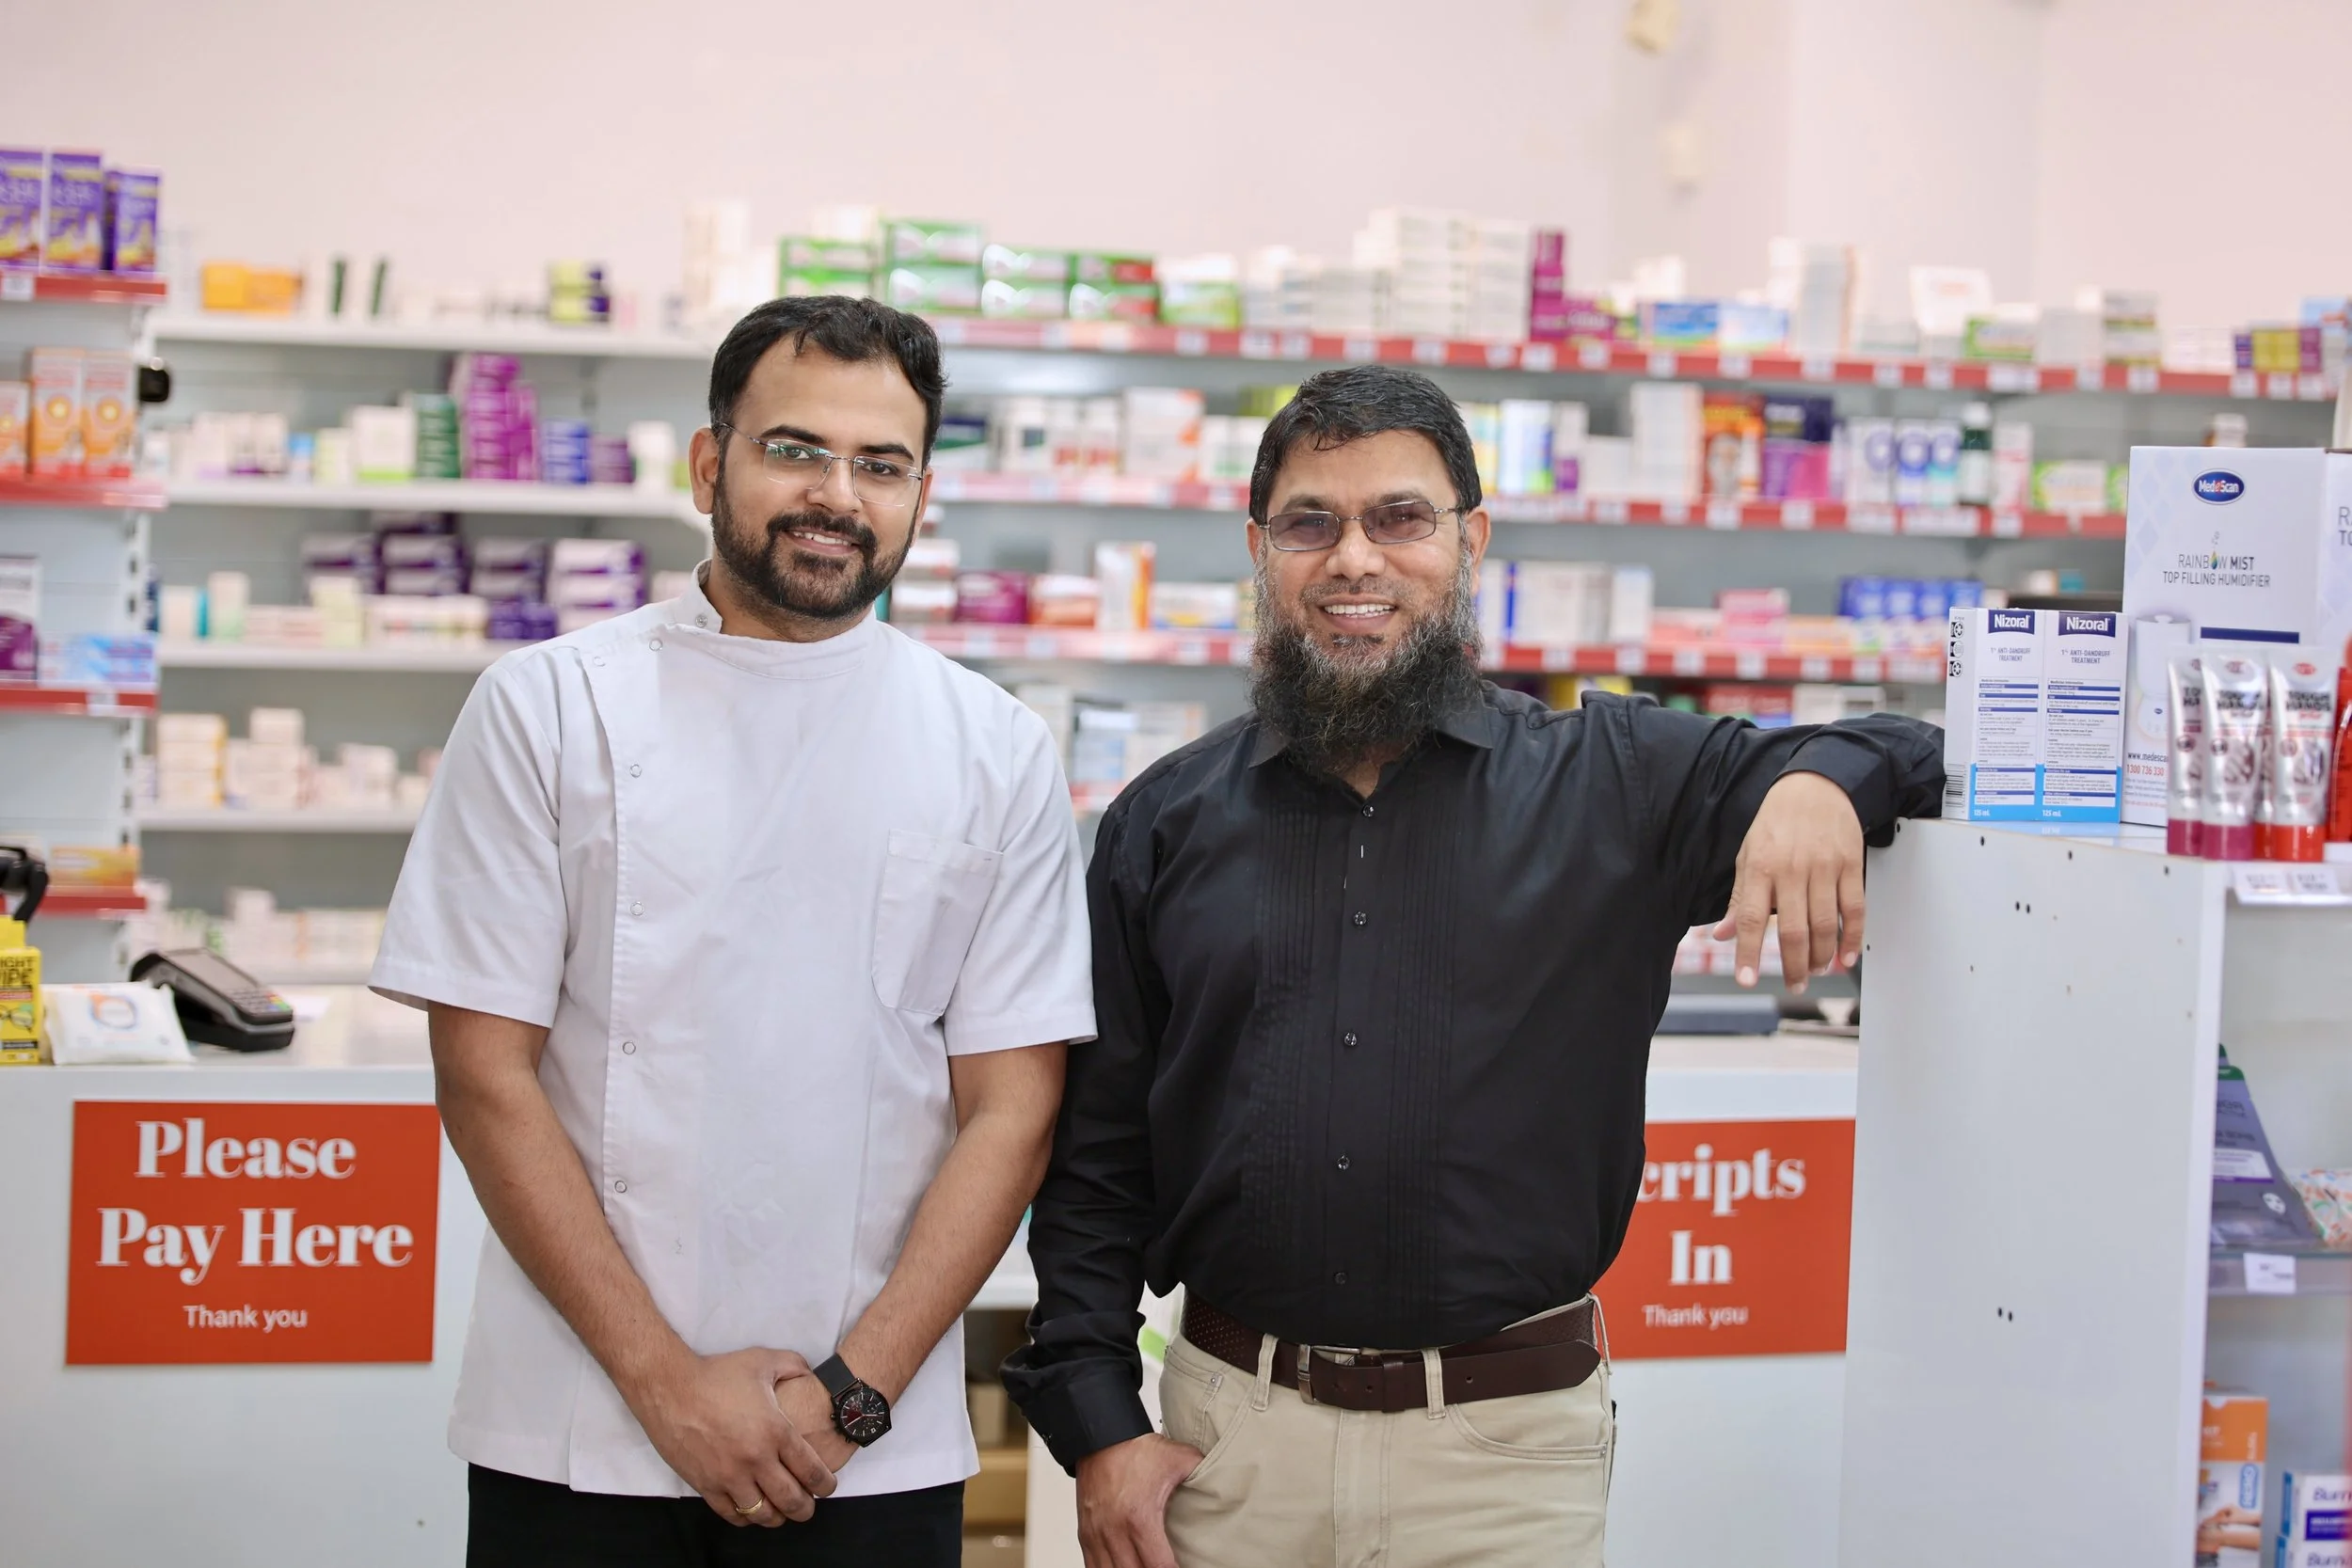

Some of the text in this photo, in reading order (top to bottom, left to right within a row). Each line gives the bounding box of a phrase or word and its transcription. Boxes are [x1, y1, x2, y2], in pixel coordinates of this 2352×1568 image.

[2198, 480, 2239, 493] MedeScan
[2230, 556, 2254, 571] MIST
[2163, 570, 2271, 588] TOP FILLING HUMIDIFIER
[1994, 614, 2029, 628] Nizoral
[2066, 617, 2109, 632] Nizoral
[2070, 649, 2110, 657] ANTI-DANDRUFF
[134, 1117, 357, 1180] Please
[1636, 1143, 1806, 1217] cripts
[96, 1207, 414, 1286] Pay Here
[1668, 1228, 1734, 1286] In
[183, 1304, 308, 1333] Thank you
[1642, 1303, 1749, 1330] Thank you
